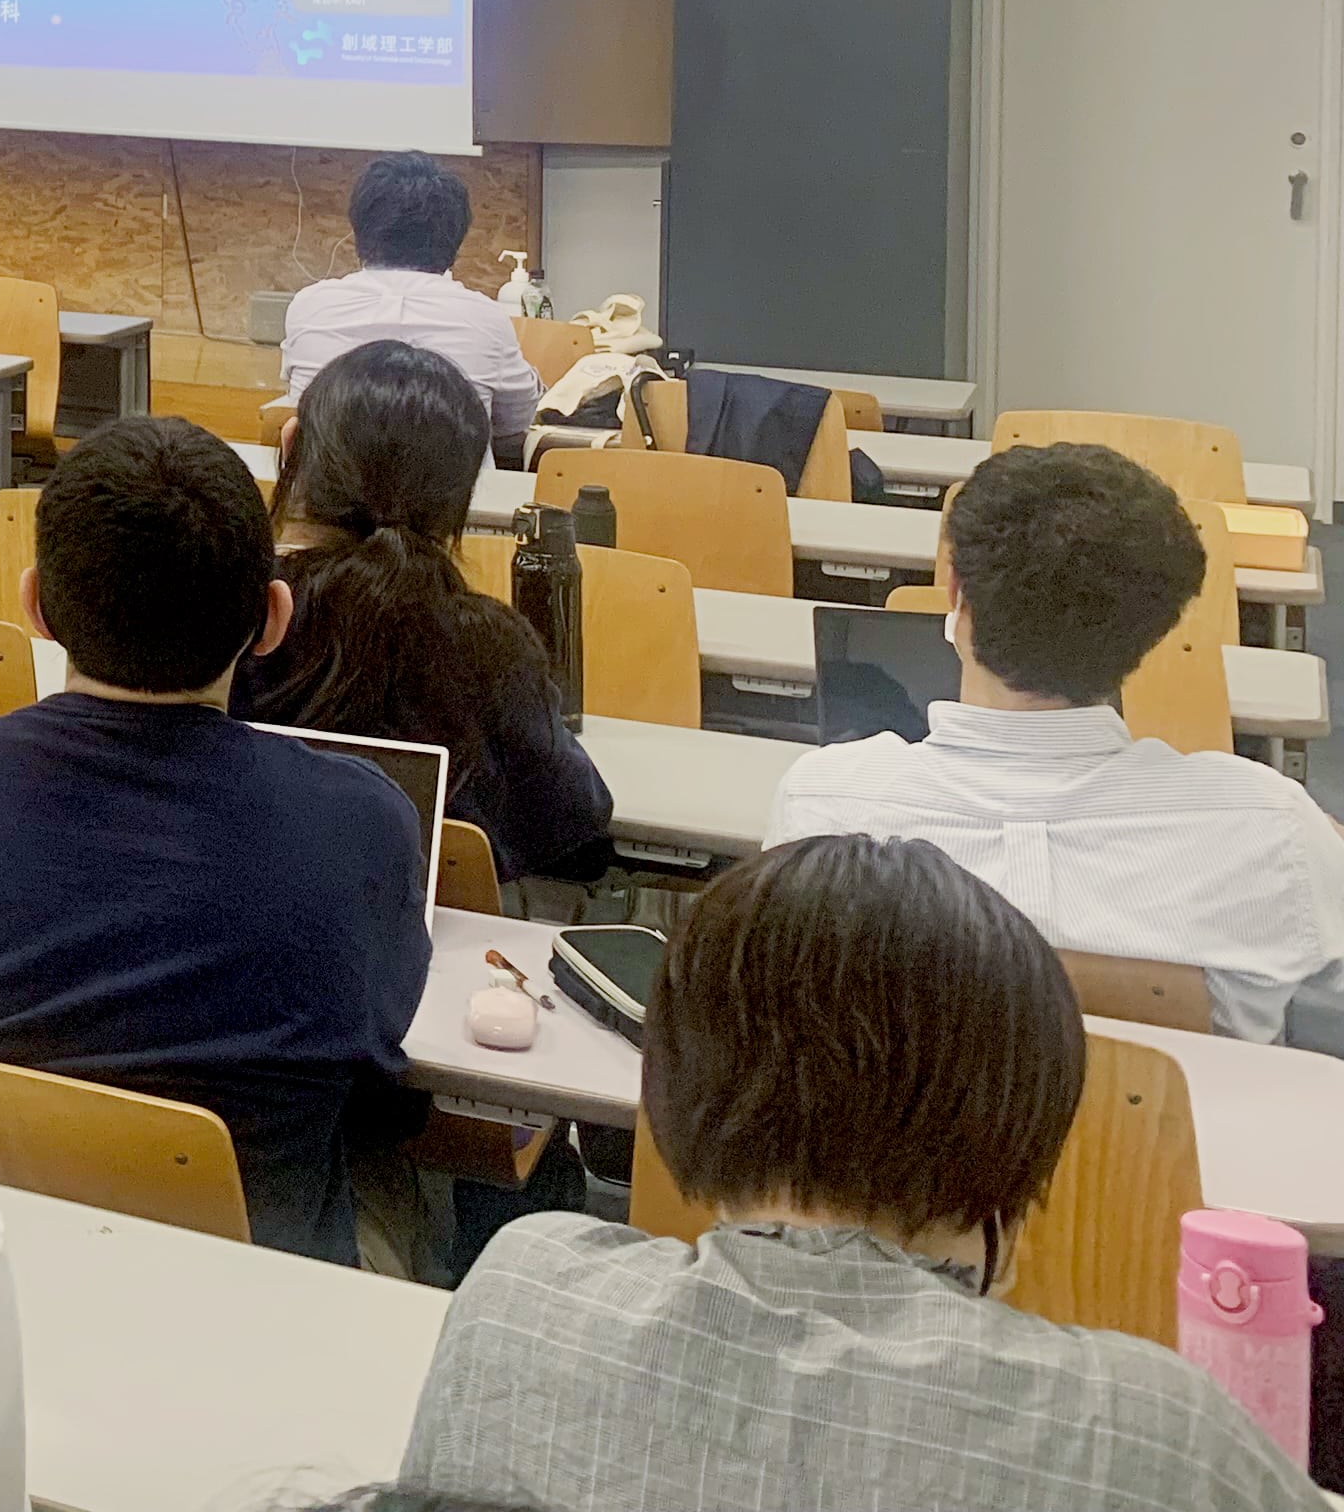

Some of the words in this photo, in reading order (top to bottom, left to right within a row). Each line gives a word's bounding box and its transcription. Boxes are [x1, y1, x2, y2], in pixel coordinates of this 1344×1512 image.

[341, 33, 454, 55] 創域理工学部
